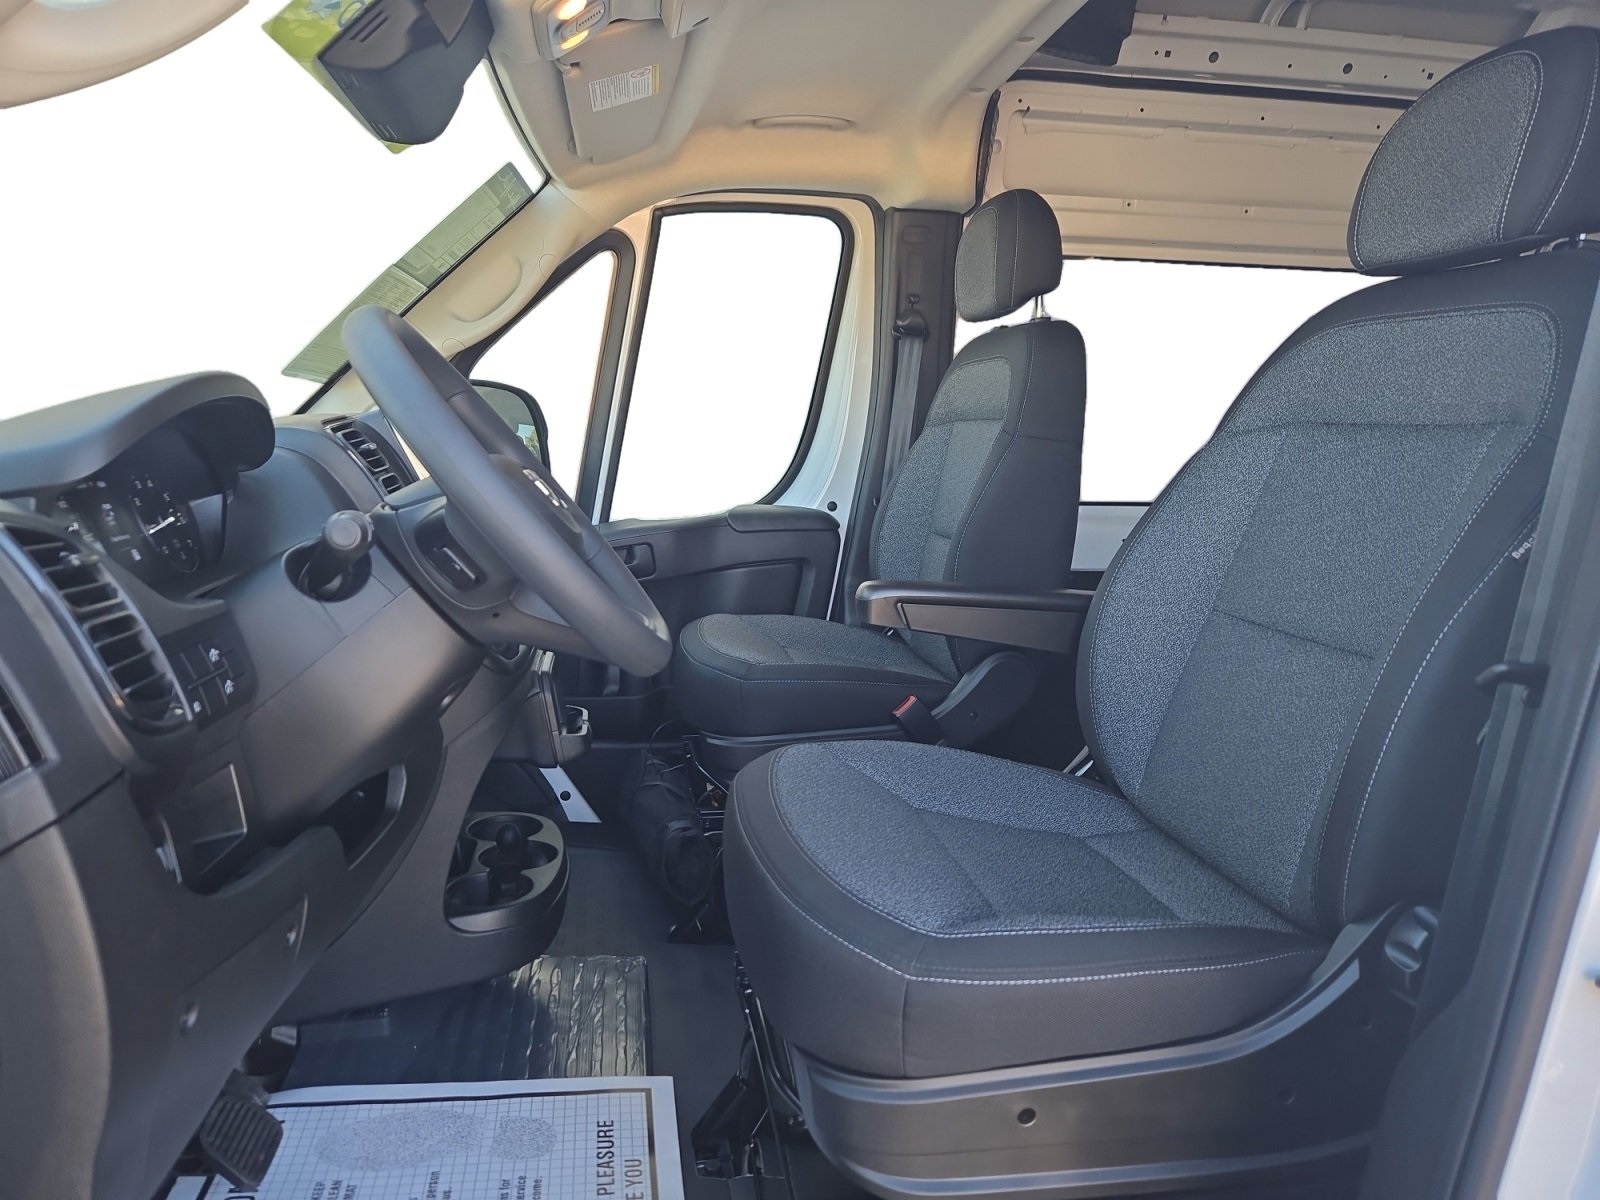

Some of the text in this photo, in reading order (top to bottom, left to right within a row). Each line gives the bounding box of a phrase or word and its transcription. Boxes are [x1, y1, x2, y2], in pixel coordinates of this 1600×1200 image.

[596, 1119, 616, 1197] PLEASURE
[426, 1170, 441, 1199] person
[623, 1158, 644, 1189] YOU
[327, 1179, 343, 1200] LEAN
[516, 1175, 527, 1200] ervice
[532, 1175, 543, 1200] come.
